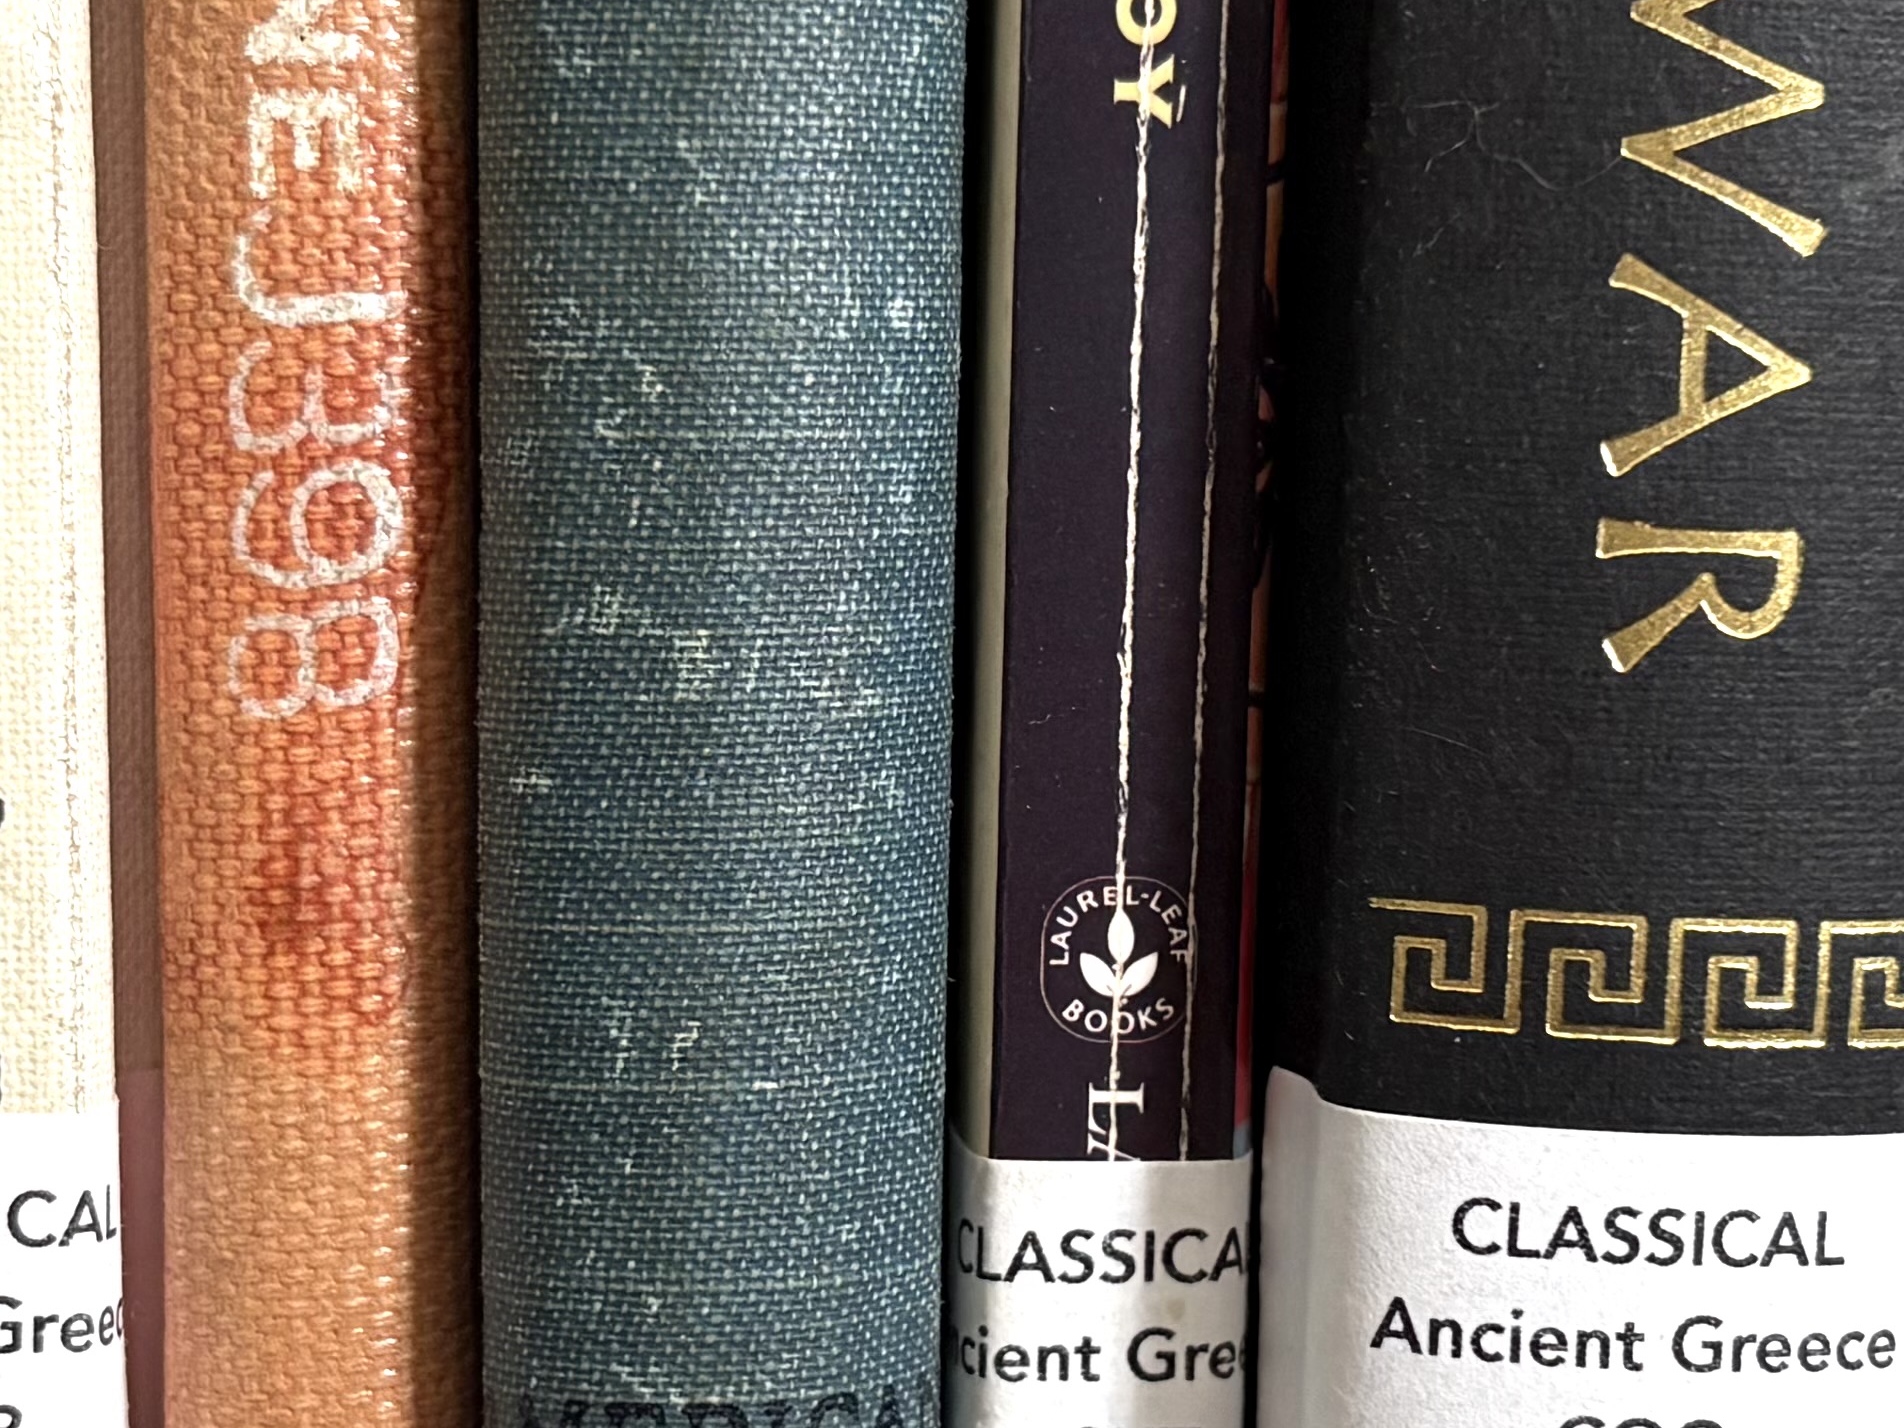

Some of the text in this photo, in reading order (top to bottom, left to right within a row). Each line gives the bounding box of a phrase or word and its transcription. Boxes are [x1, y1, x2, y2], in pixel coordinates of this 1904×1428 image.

[1049, 883, 1190, 966] LAUREL-LEAF
[1061, 996, 1175, 1035] BOOKS
[957, 1218, 1250, 1284] CLASSICA
[1449, 1195, 1847, 1270] CLASSICAL
[1367, 1295, 1898, 1375] Ancient Greece
